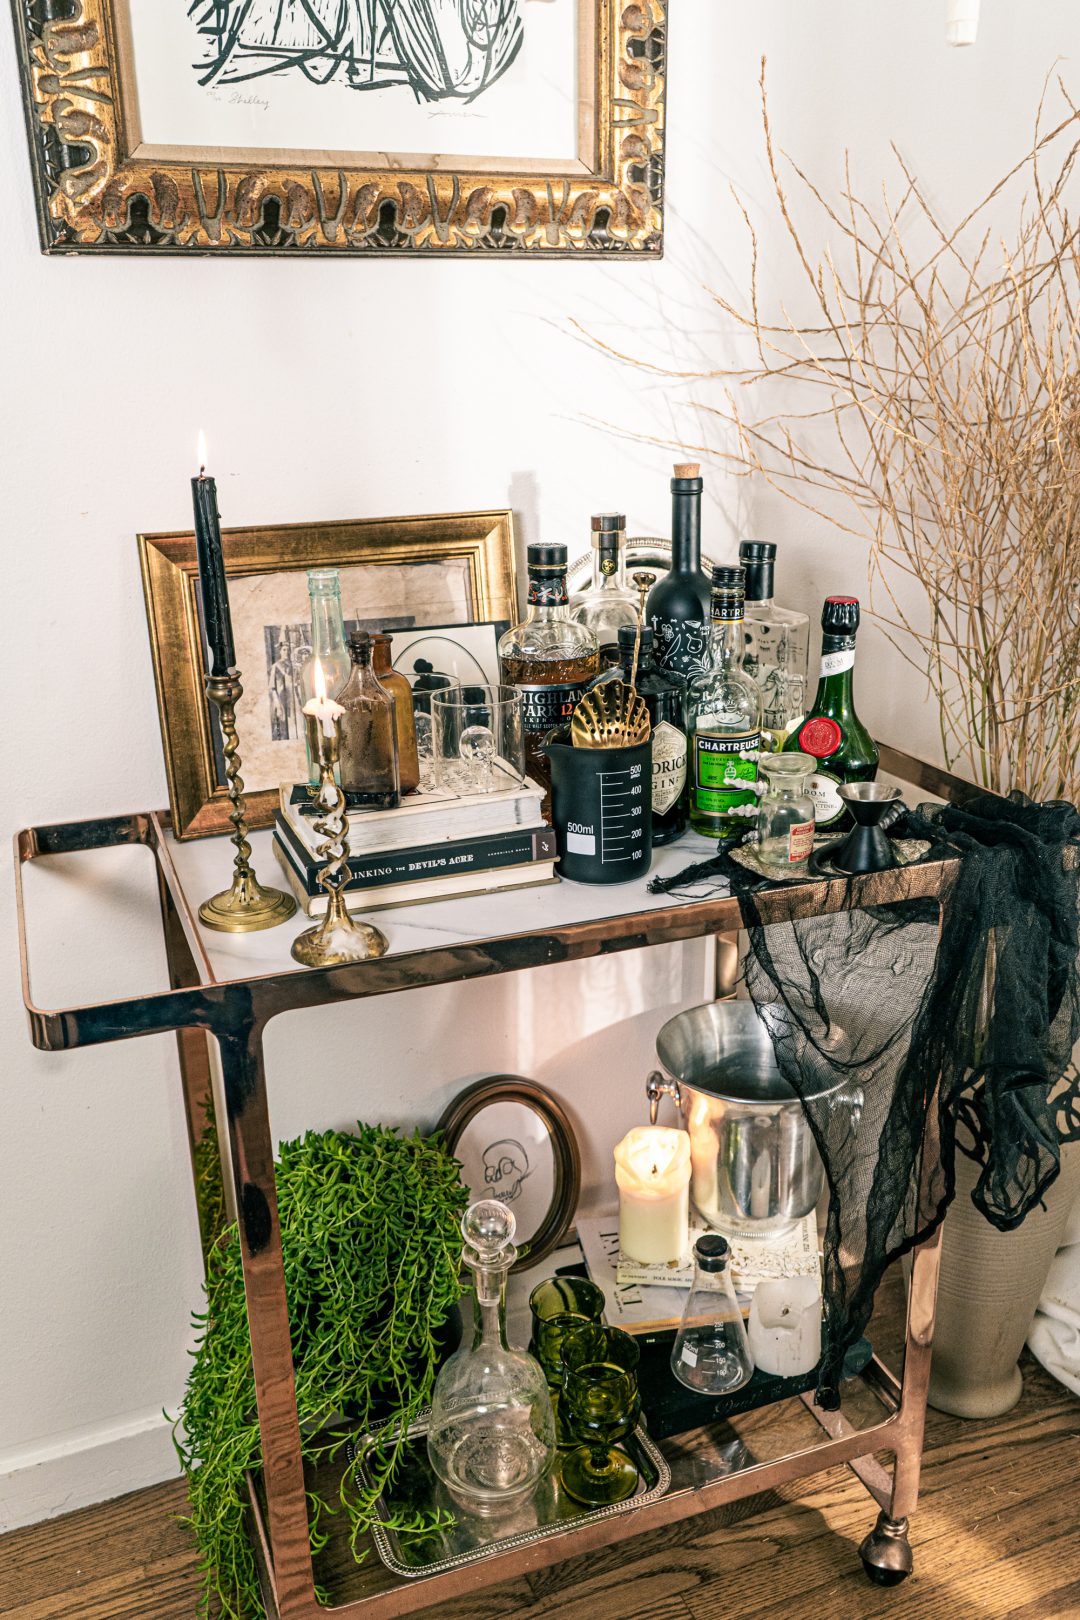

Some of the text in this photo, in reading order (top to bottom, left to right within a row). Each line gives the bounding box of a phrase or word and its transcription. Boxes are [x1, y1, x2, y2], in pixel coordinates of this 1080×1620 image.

[561, 703, 573, 716] 12
[698, 738, 759, 752] CHARTREUSE
[630, 764, 642, 775] 500
[652, 777, 675, 790] GIN
[630, 785, 642, 795] 400
[631, 806, 642, 817] 300
[567, 822, 594, 835] 500ml
[631, 829, 642, 839] 200
[631, 850, 642, 860] 100
[338, 866, 393, 882] INKING
[408, 858, 447, 871] DEVIL'S
[448, 854, 474, 865] ACRE
[716, 1357, 726, 1365] 150
